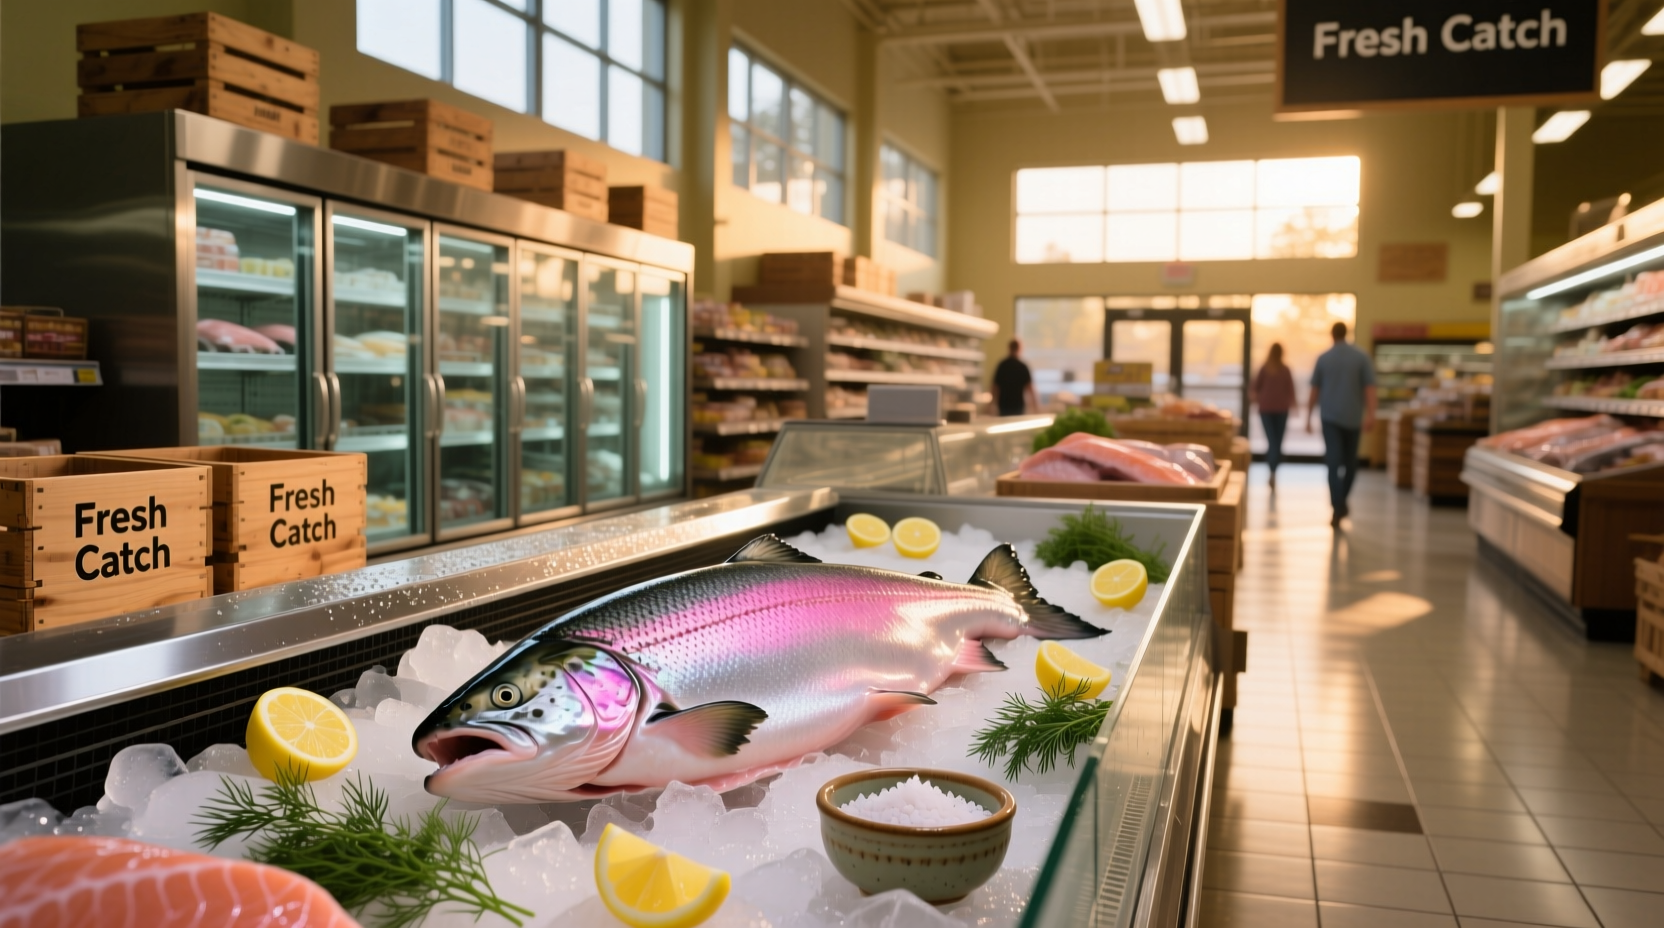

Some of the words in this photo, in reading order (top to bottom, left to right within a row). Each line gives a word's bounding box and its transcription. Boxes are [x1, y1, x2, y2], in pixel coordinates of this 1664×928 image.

[1313, 16, 1428, 60] Fresh
[1440, 8, 1567, 53] Catch
[75, 495, 167, 538] Fresh
[269, 479, 335, 513] Fresh
[269, 513, 337, 549] Catch
[75, 536, 171, 581] Catch
